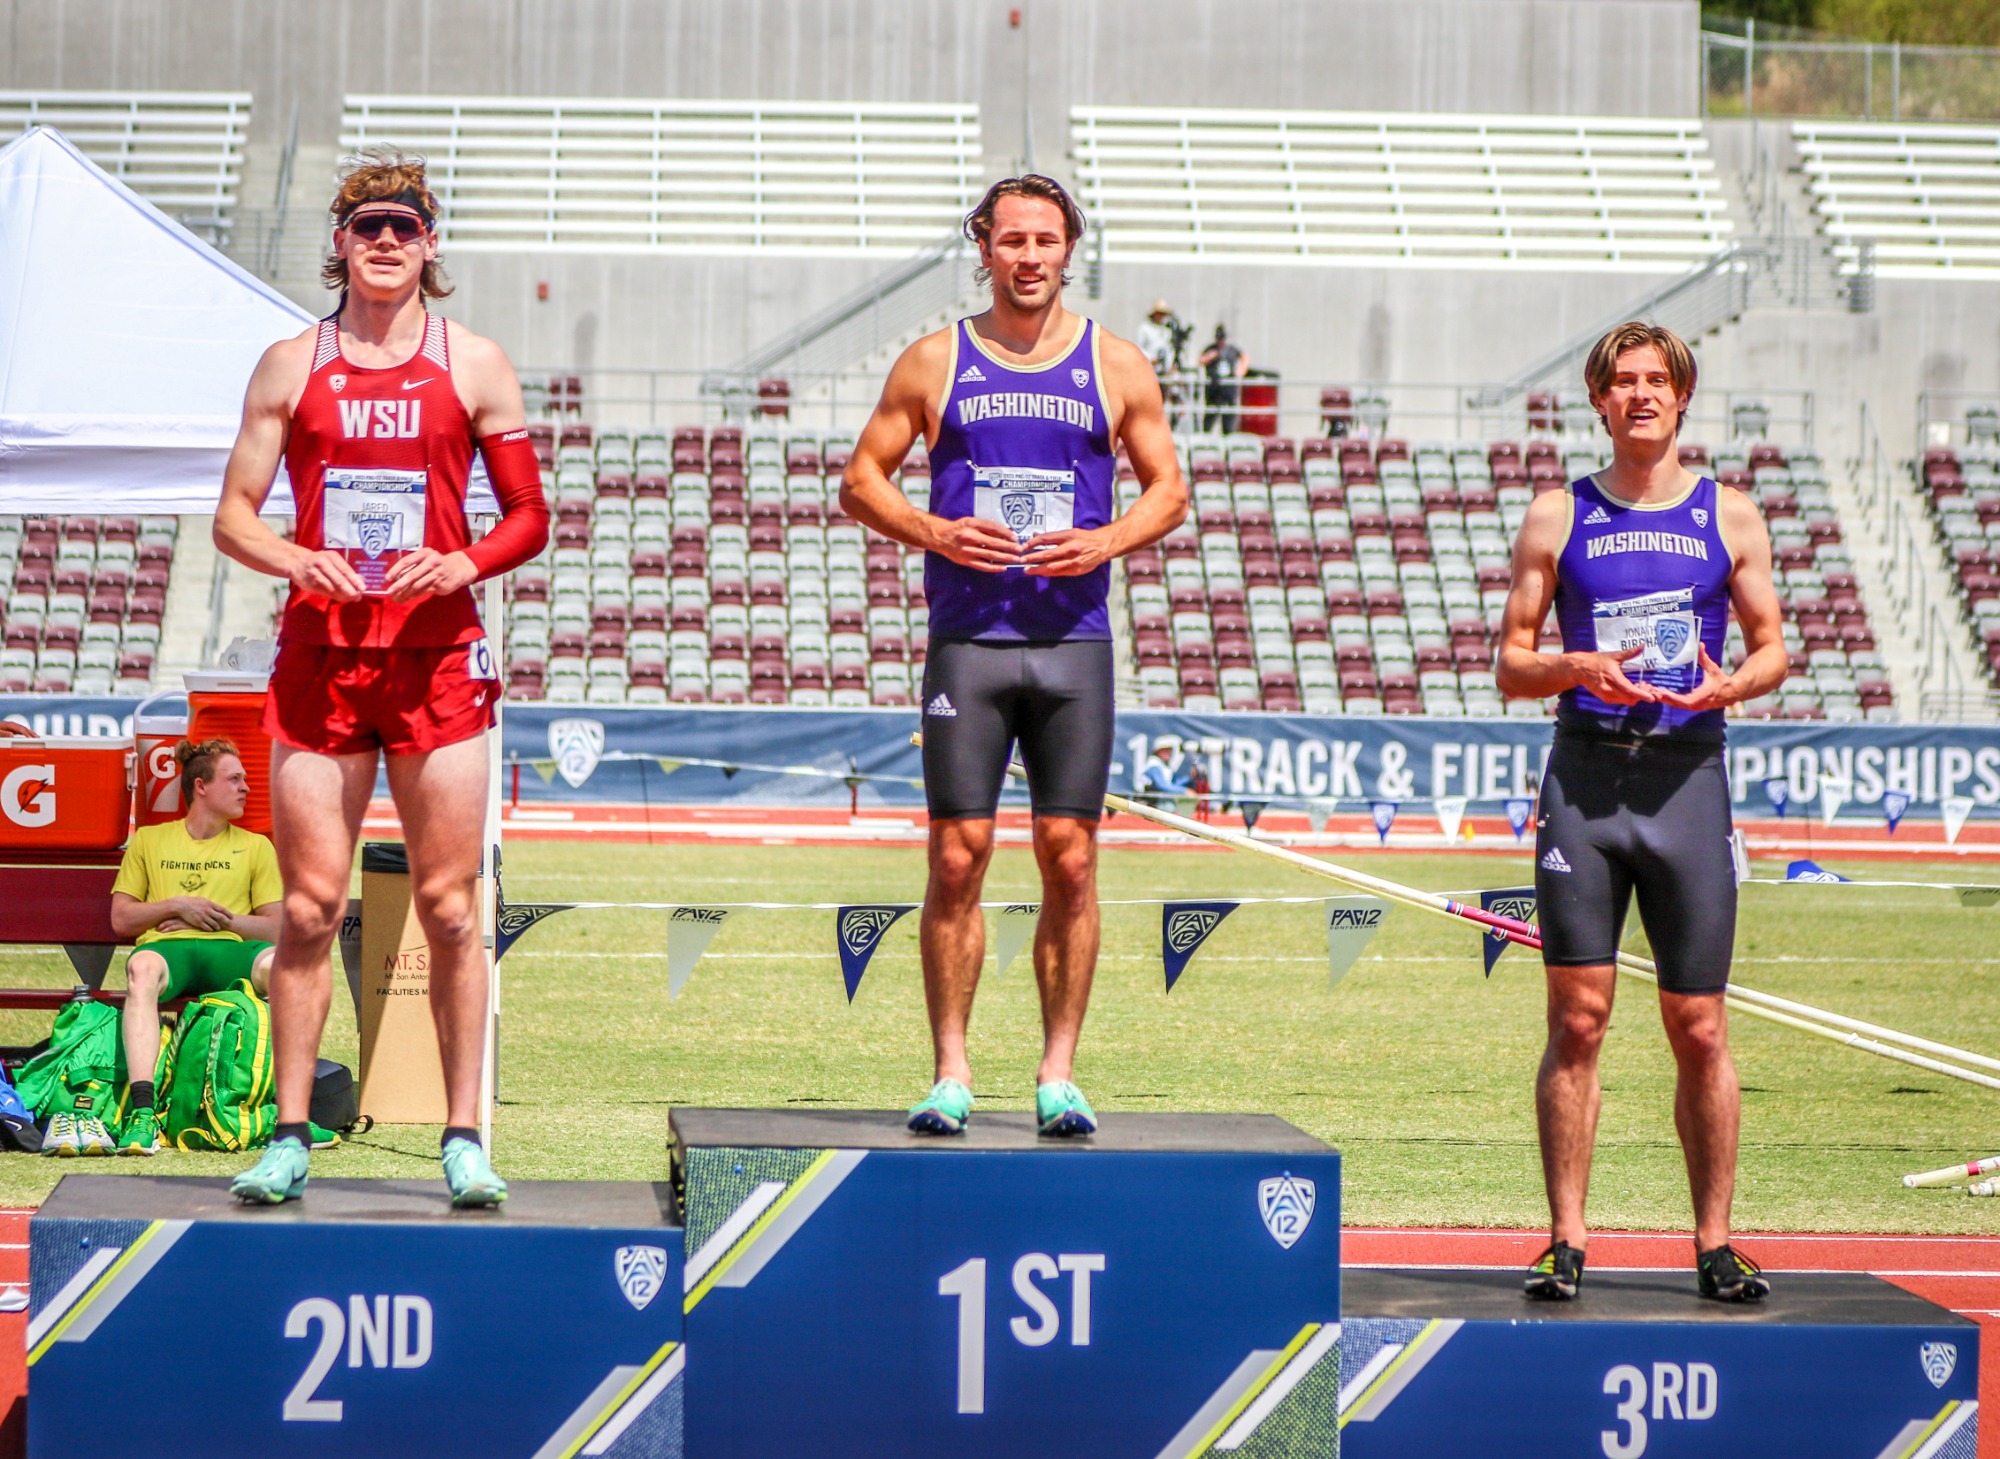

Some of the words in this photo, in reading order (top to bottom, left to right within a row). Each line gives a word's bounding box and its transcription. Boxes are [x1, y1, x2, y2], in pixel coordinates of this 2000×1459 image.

[337, 400, 421, 438] WSU
[957, 392, 1094, 432] WASHINGTON
[352, 481, 414, 493] CHAMPIONSHIPS
[1004, 480, 1062, 492] CHAMPIONSHIPS
[1583, 517, 1611, 525] adidas
[1586, 531, 1709, 561] WASHINGTON
[1621, 602, 1680, 616] CHAMPIONSHIPS
[928, 708, 957, 716] adidas
[149, 746, 176, 780] G
[1200, 737, 1363, 796] TRACK
[1377, 741, 1415, 799] &
[1723, 745, 2000, 804] PIONSHIPS
[0, 764, 56, 828] G
[161, 860, 201, 871] FIGHTING
[1541, 860, 1571, 873] adidas
[671, 917, 722, 925] CONFERENCE
[851, 928, 872, 944] 12
[1176, 931, 1195, 945] 12
[384, 954, 412, 971] MT.
[410, 973, 430, 981] Anton
[376, 988, 420, 996] FACILITIES
[1263, 1182, 1312, 1216] PAC
[1277, 1215, 1297, 1234] 12
[620, 1250, 664, 1283] PAC
[632, 1279, 650, 1297] 12
[938, 1252, 1105, 1414] 1ST
[282, 1294, 434, 1421] 2ND
[1601, 1361, 1718, 1459] 3RD
